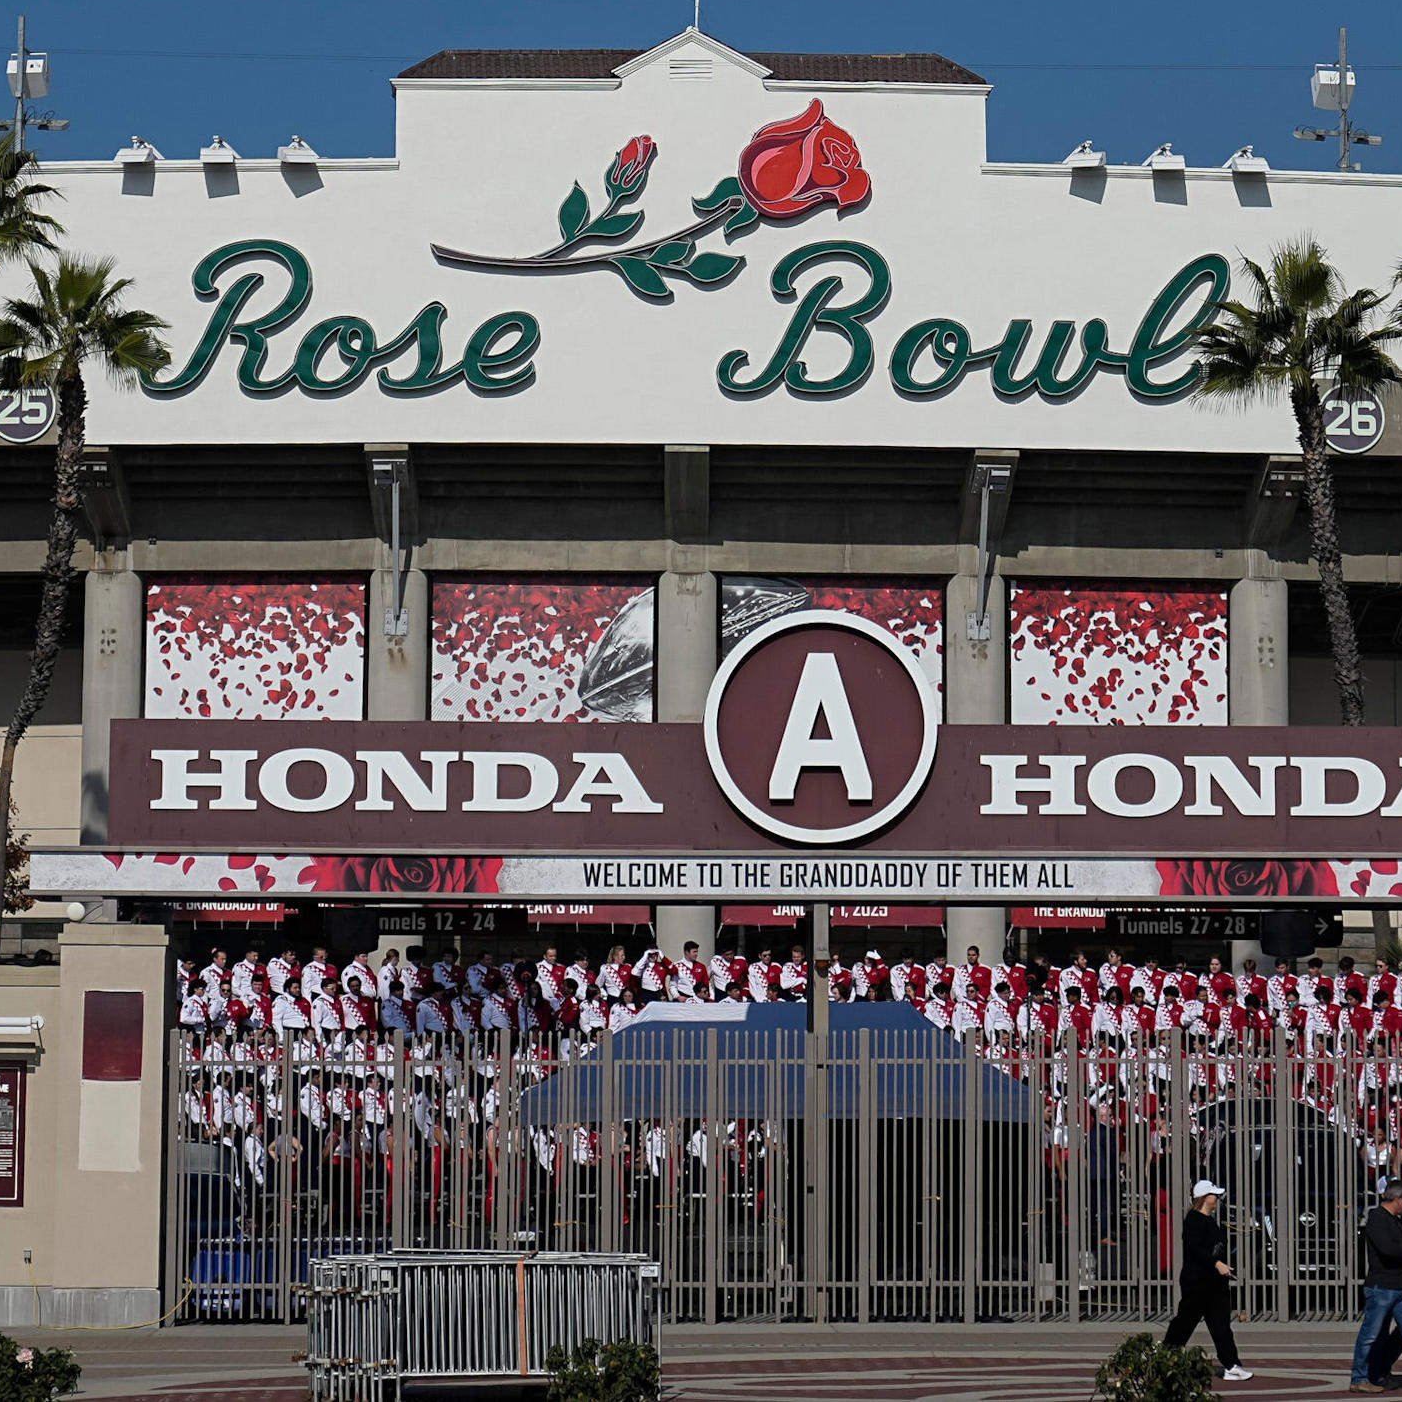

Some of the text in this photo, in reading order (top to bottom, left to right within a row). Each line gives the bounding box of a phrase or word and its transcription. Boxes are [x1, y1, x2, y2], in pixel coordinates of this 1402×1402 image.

[137, 238, 1231, 398] Rose Bowl
[1325, 400, 1377, 436] 26
[769, 652, 873, 801] A
[150, 748, 663, 813] HONDA
[583, 863, 1074, 889] WELCOME TO THE GRANDDADDY OF THEM ALL
[379, 912, 426, 931] nnels
[434, 912, 454, 931] 12
[473, 912, 495, 931] 24
[1117, 915, 1246, 935] Tunnels 27 28
